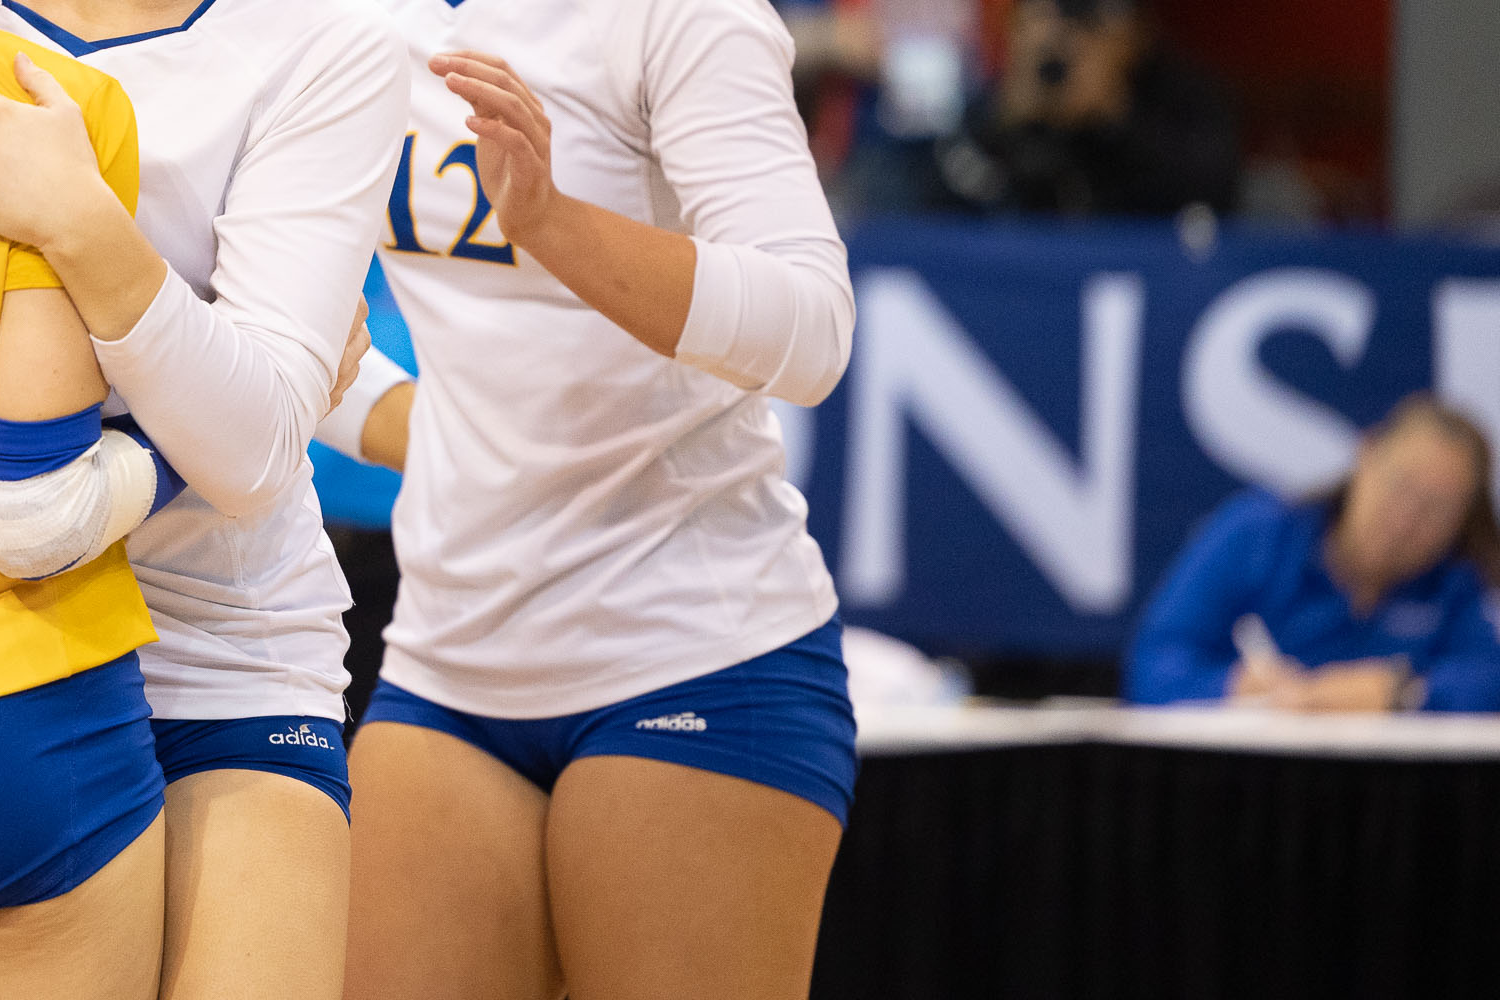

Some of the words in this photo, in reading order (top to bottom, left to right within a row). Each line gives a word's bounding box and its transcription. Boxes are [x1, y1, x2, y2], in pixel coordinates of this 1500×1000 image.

[382, 130, 519, 267] 12
[770, 262, 1500, 613] NS
[268, 726, 335, 750] adida
[635, 715, 708, 732] adidas
